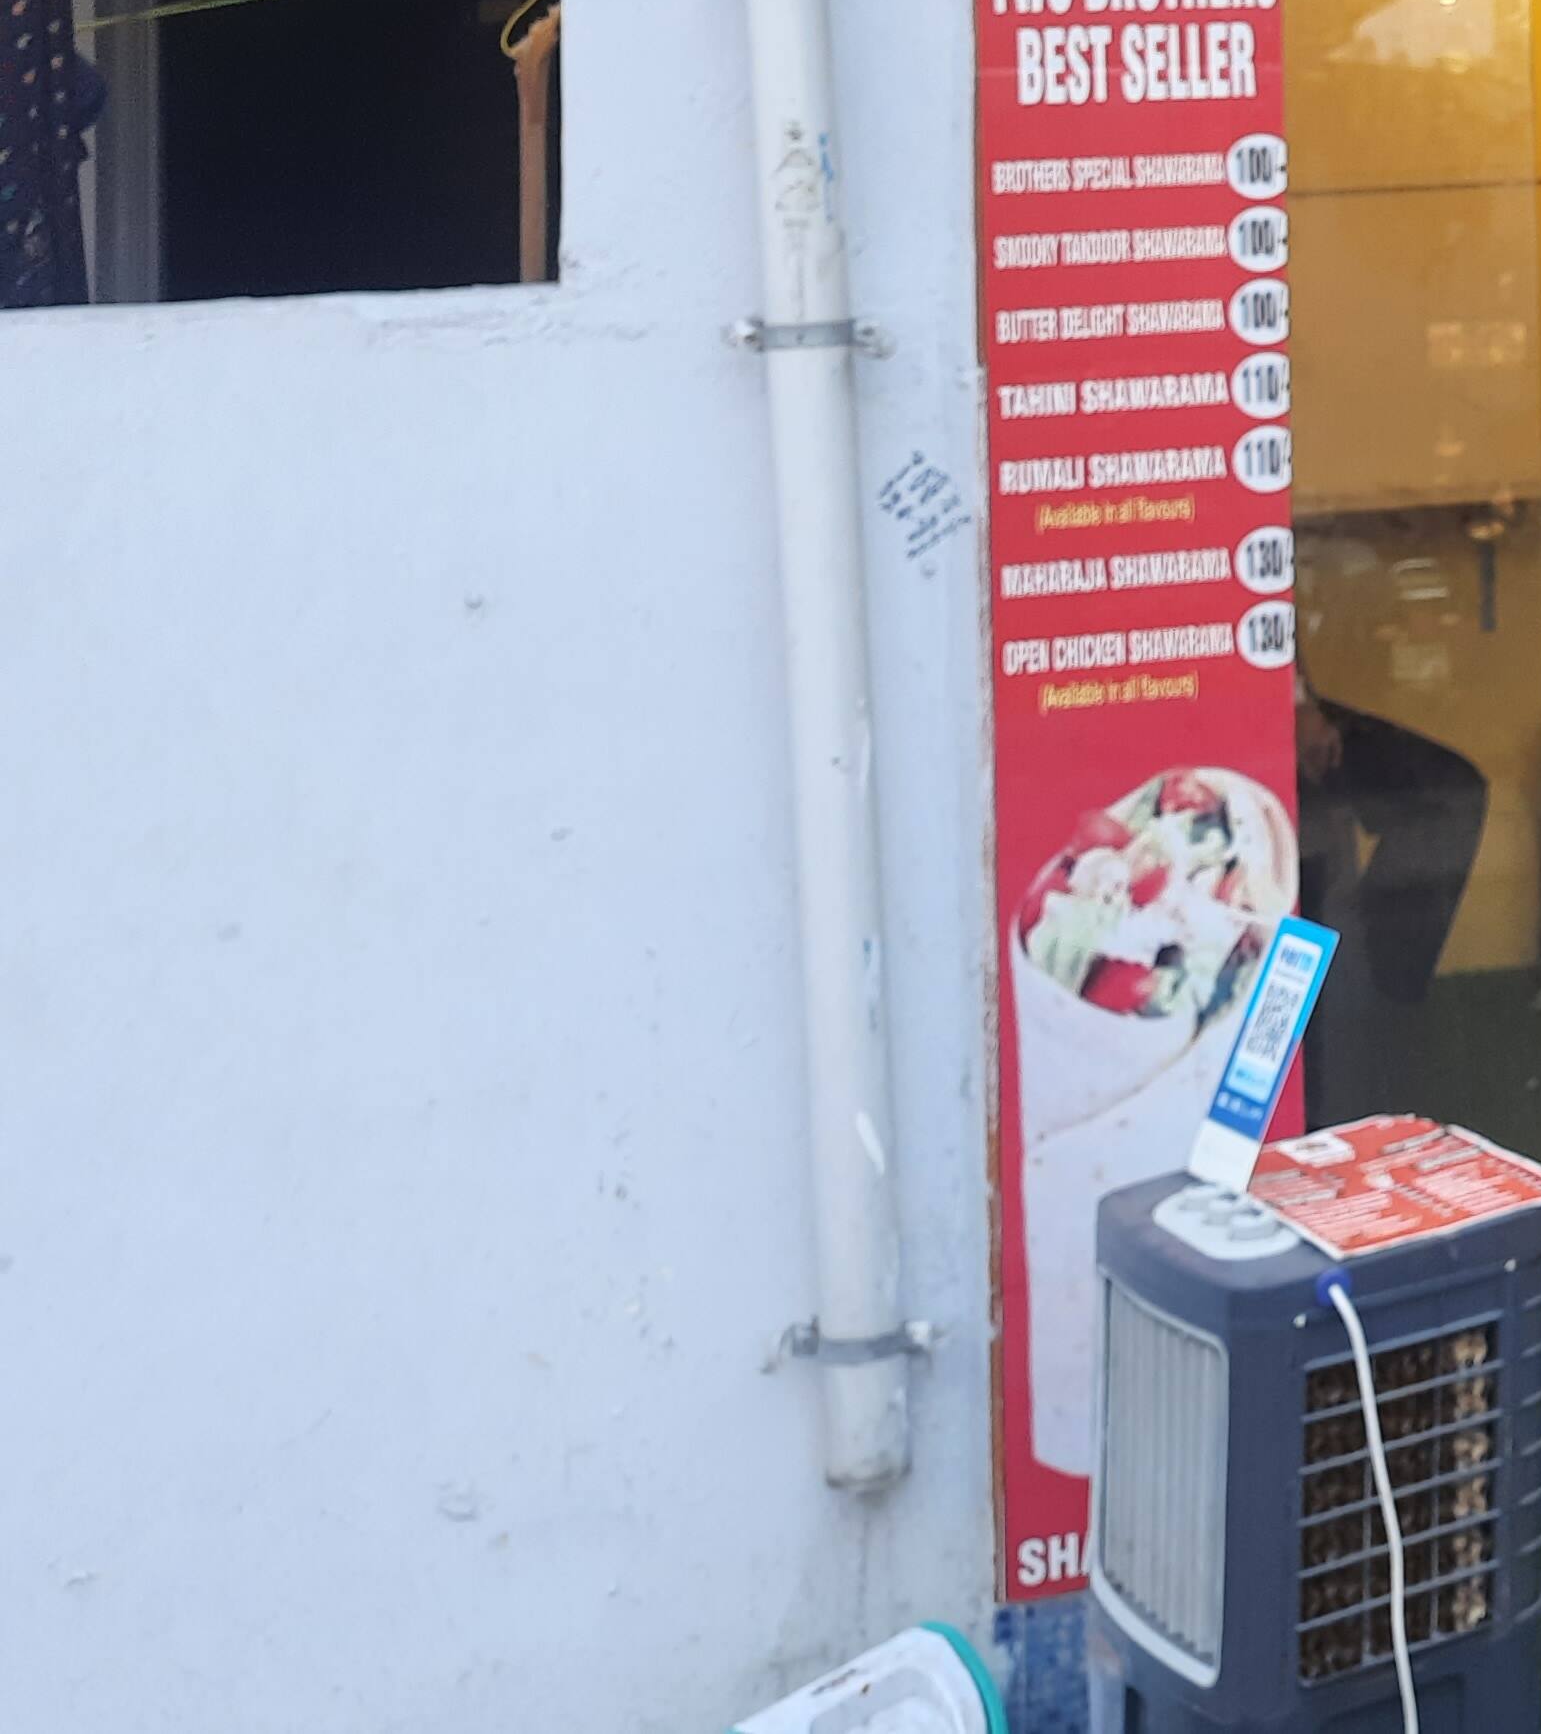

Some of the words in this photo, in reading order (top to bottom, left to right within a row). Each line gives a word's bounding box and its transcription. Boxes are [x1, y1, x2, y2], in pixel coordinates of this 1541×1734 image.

[1015, 23, 1113, 106] BEST
[1120, 21, 1257, 103] SELLER
[991, 159, 1071, 195] BROTHERS
[1071, 156, 1135, 191] SPECIAL
[995, 309, 1058, 344] BUTTER
[1058, 304, 1125, 340] DELIGHT
[999, 457, 1086, 496] RUMALI
[1001, 557, 1109, 601] MAHARAJA
[1003, 639, 1051, 677] OPEN
[1051, 632, 1127, 672] CHICKEN
